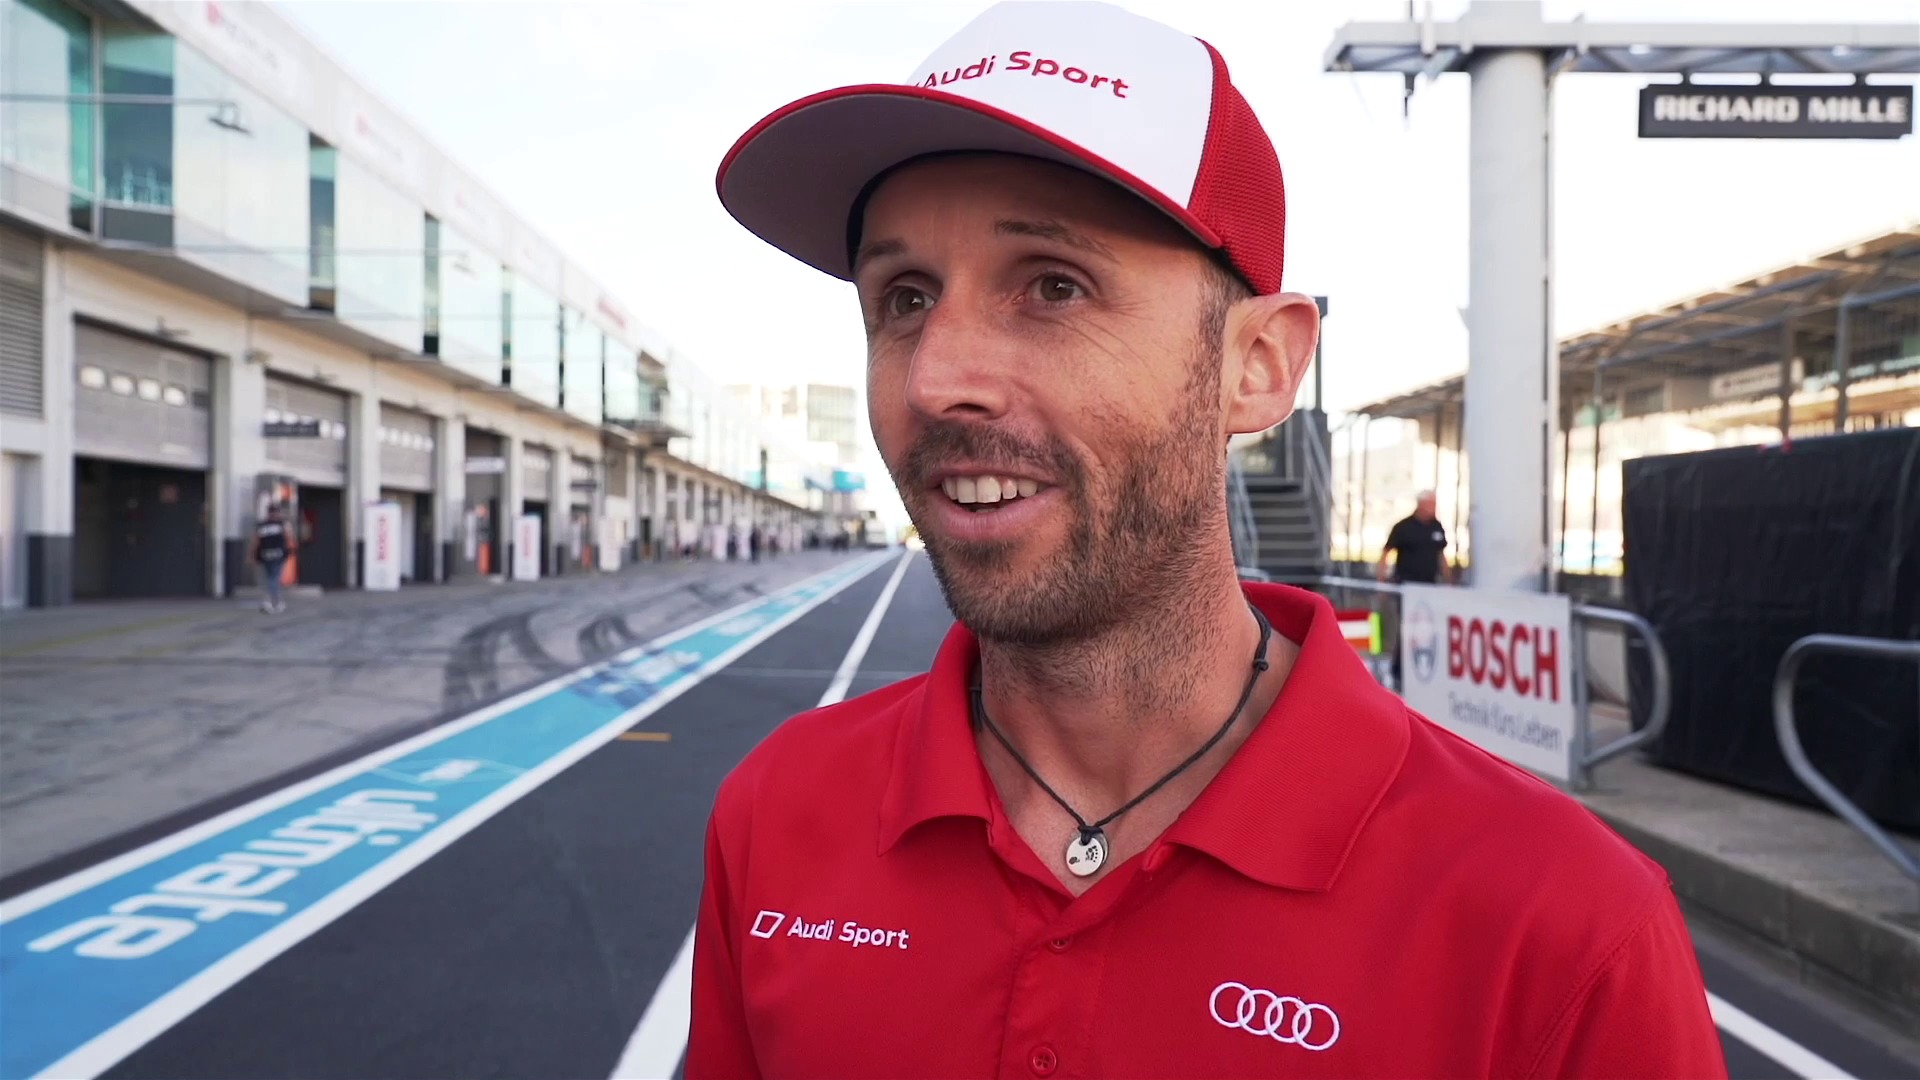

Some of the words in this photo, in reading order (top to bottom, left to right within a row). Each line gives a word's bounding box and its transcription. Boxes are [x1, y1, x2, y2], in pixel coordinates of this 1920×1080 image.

[921, 55, 996, 88] Audi
[1005, 51, 1129, 99] Sport
[1653, 94, 1800, 123] RICHARD
[1807, 96, 1909, 123] MILLE
[1447, 615, 1561, 703] BOSCH
[787, 916, 835, 941] Audi
[838, 921, 910, 950] Sport
